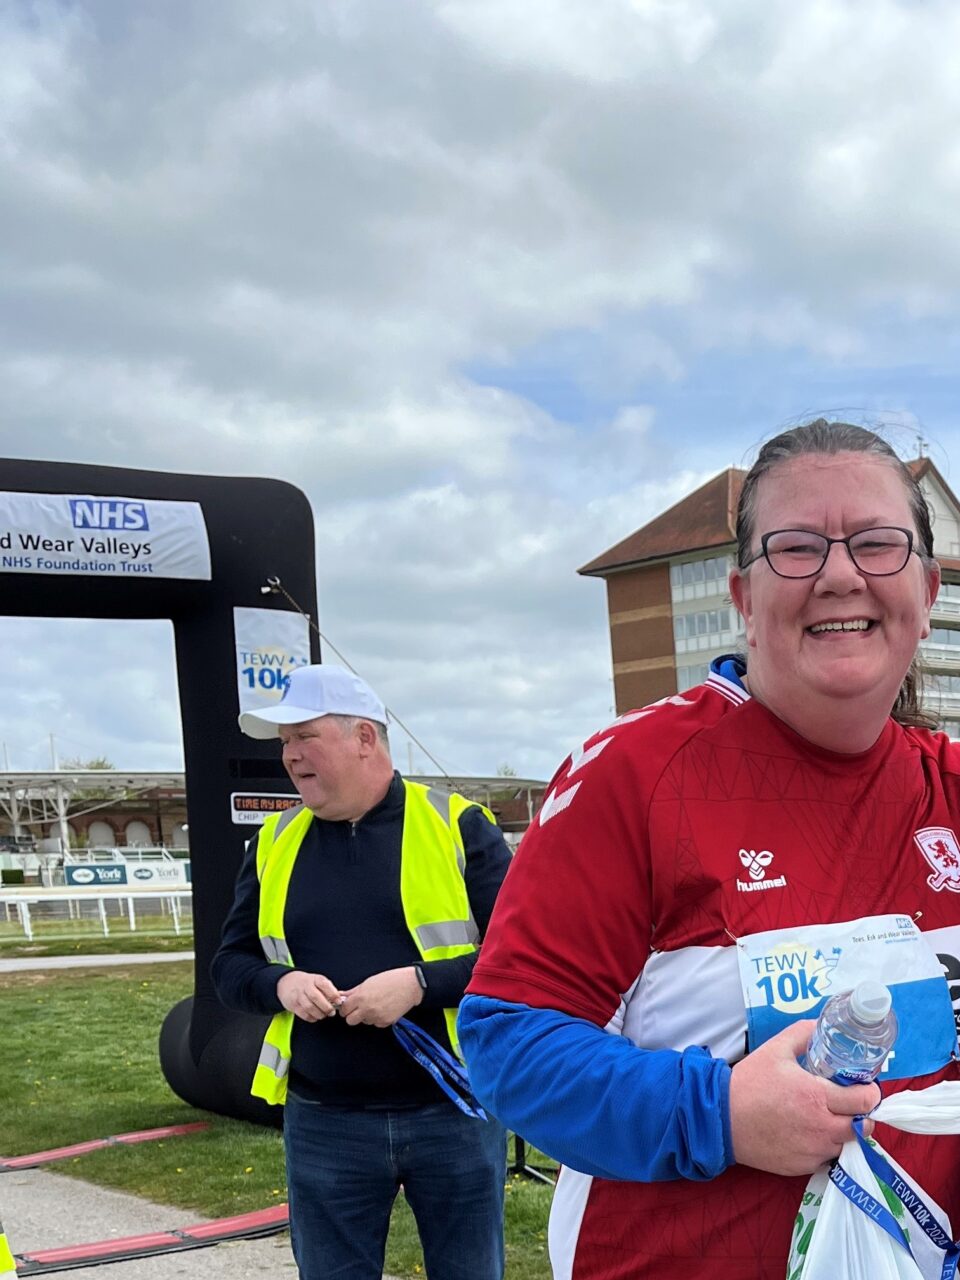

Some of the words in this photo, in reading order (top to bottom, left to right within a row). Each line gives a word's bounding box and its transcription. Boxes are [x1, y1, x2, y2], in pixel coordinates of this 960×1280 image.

[75, 501, 145, 530] NHS
[18, 533, 74, 552] Wear
[81, 537, 152, 559] Valleys
[2, 556, 32, 568] NHS
[37, 556, 116, 572] Foundation
[120, 560, 153, 573] Trust
[240, 651, 285, 666] TEWV
[242, 667, 290, 690] 10k
[235, 798, 259, 809] TIME
[275, 799, 297, 810] RAC
[96, 867, 121, 879] York
[156, 867, 179, 878] York
[736, 875, 787, 892] hummel
[752, 950, 808, 974] TEWV
[755, 969, 822, 1005] 10k
[844, 1181, 883, 1220] TEWV
[890, 1175, 918, 1208] TEWV
[913, 1204, 931, 1226] 10k
[925, 1221, 949, 1246] 2024
